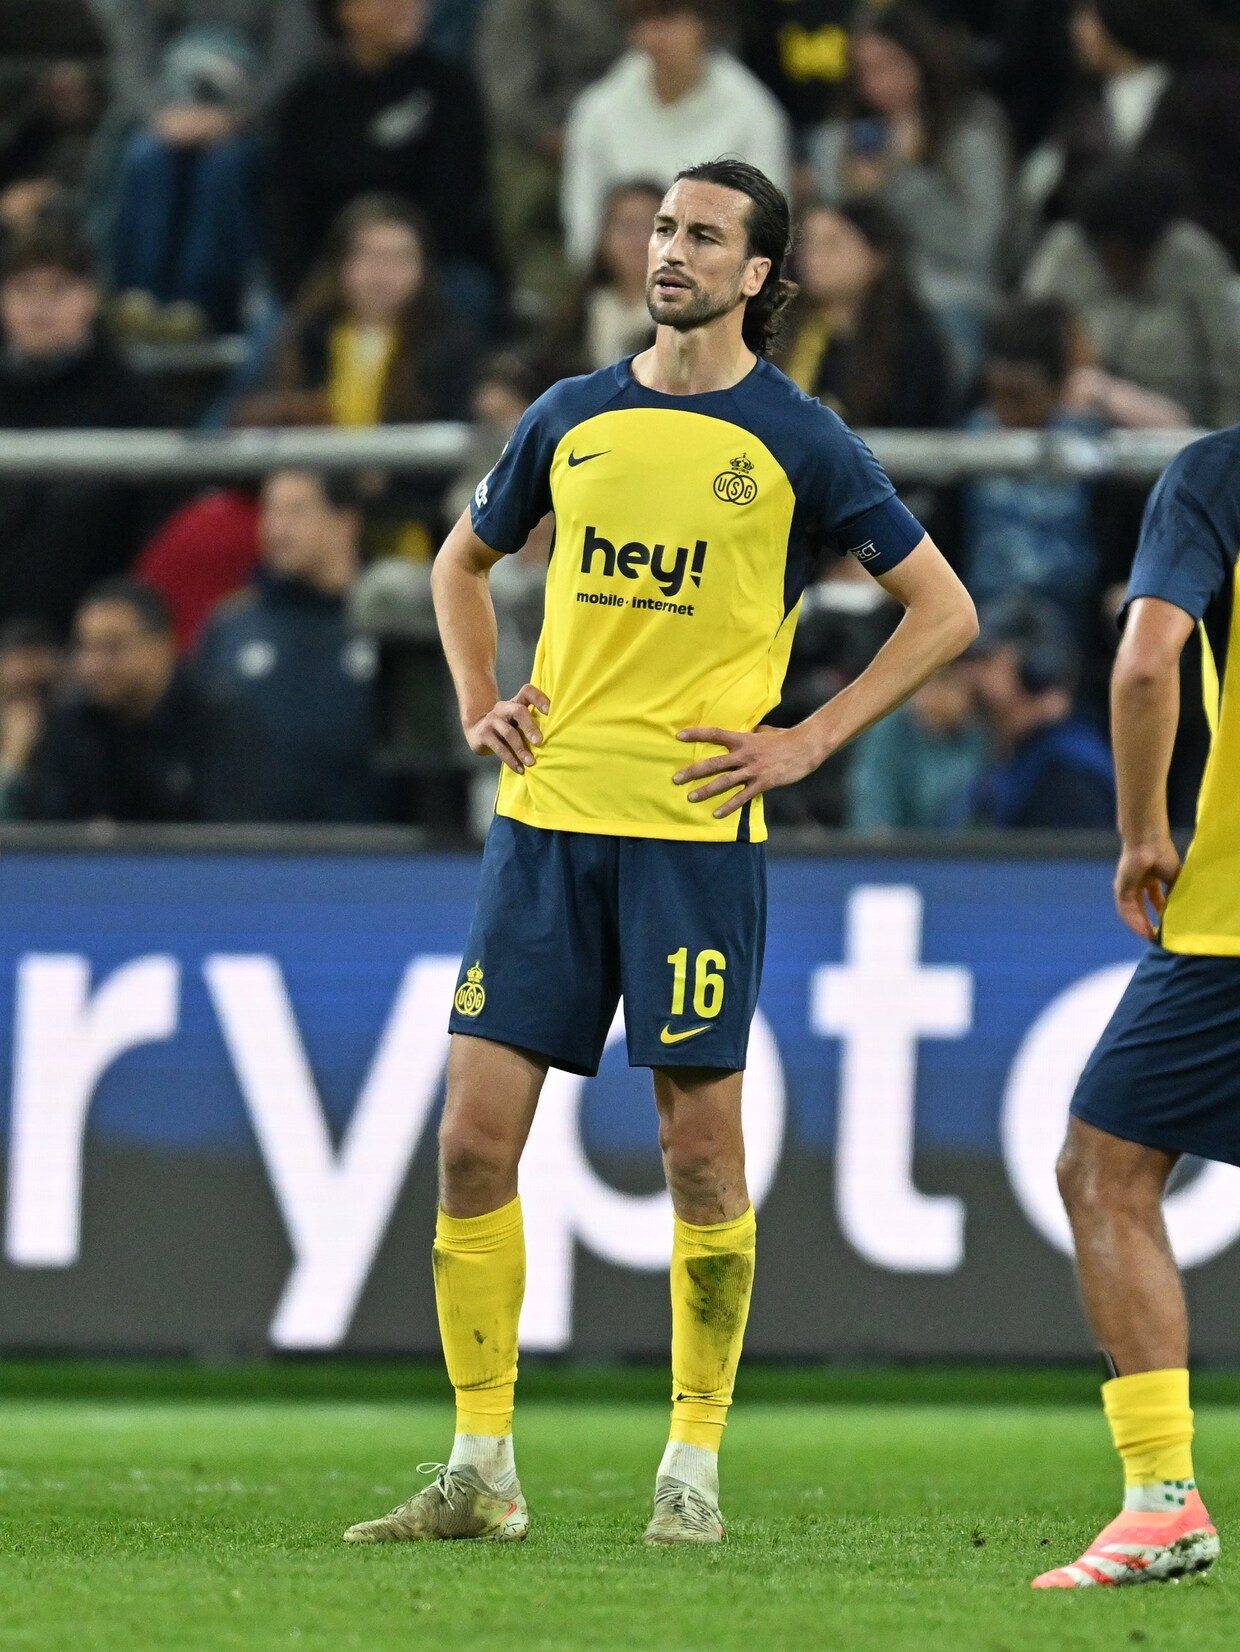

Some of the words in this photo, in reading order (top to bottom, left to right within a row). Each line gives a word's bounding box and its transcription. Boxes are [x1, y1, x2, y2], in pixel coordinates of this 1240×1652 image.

[580, 525, 708, 597] hey!
[855, 542, 876, 559] ECT
[576, 592, 625, 607] mobile
[631, 596, 695, 617] internet
[667, 947, 726, 1019] 16
